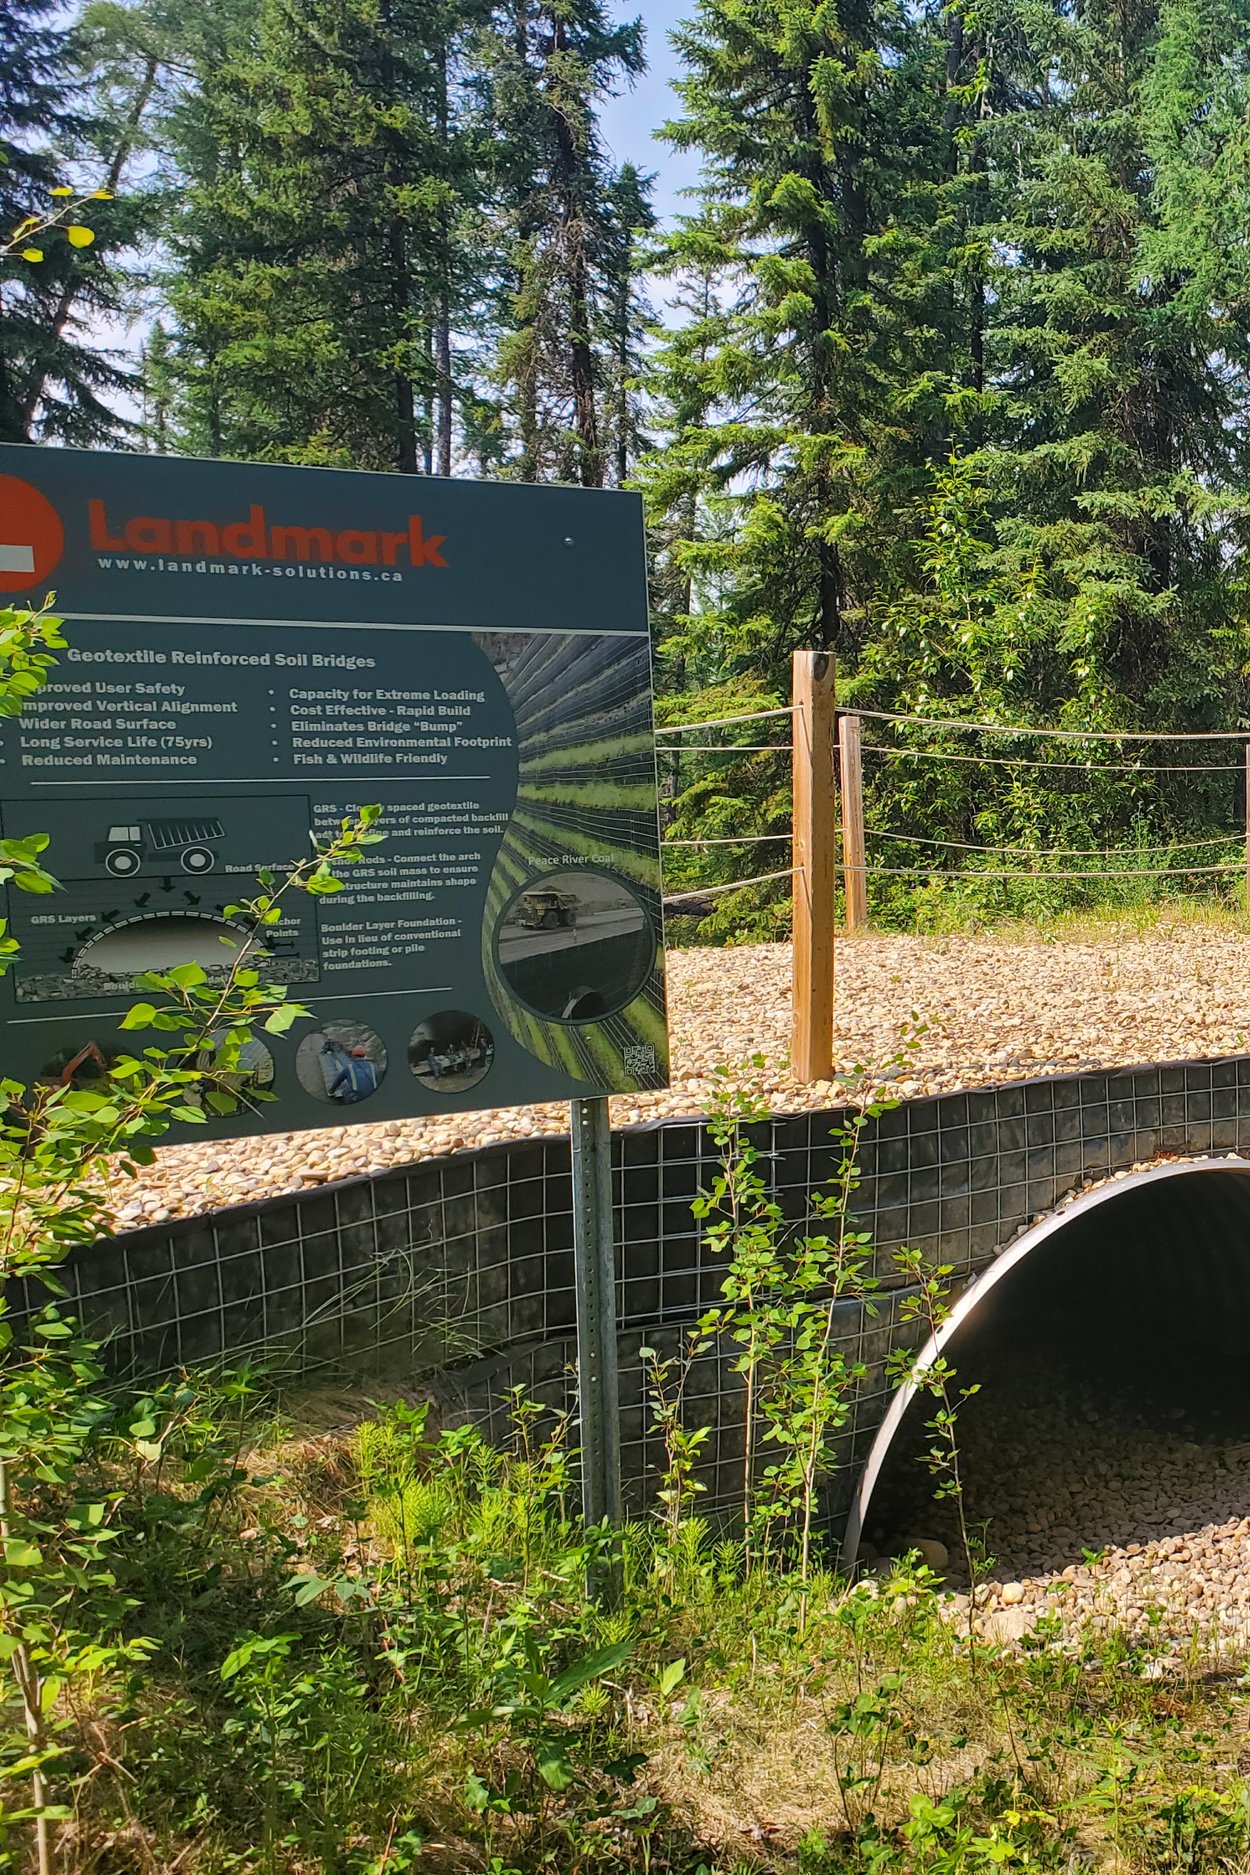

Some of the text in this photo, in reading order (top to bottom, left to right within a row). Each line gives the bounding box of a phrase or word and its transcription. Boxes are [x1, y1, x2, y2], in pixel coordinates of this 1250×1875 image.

[88, 498, 449, 568] Landmark
[98, 558, 403, 582] www.landmark-solutions.ca
[68, 649, 376, 670] Geotextile Reinforced Soil Bridges
[37, 682, 186, 696] proved User Safety
[289, 688, 486, 702] Capacity for Extreme Loading
[23, 700, 238, 714] mproved Vertical Alignment
[290, 704, 323, 716] Cost
[325, 705, 387, 716] Effective
[396, 705, 435, 717] Rapid
[438, 705, 471, 716] Build
[19, 718, 177, 729] Wider Road Surface
[291, 721, 365, 732] Eliminates
[367, 721, 411, 734] Bridge
[20, 735, 213, 749] Long Service Life (75yrs)
[292, 736, 512, 748] Reduced Environmental Footprint
[22, 753, 198, 766] Reduced Maintenance
[293, 752, 448, 765] Fish & Wildlife Friendly
[313, 804, 337, 813] GRS
[387, 803, 425, 813] spaced
[427, 801, 480, 812] geotextile
[314, 817, 360, 826] betwen
[398, 815, 410, 824] of
[412, 814, 469, 825] compacted
[471, 812, 509, 822] backfill
[391, 828, 411, 837] and
[413, 826, 461, 836] reinforce
[463, 825, 481, 834] the
[483, 825, 504, 834] soil.
[393, 853, 437, 863] Connect
[439, 852, 456, 861] the
[458, 851, 481, 860] arch
[528, 852, 615, 865] Peace River Coal
[225, 864, 253, 873] Road
[331, 865, 479, 878] the GRS soil mass to ensure
[345, 877, 476, 891] tructure maintains shape
[319, 891, 435, 905] during the backfilling.
[31, 914, 97, 924] GRS Layers
[321, 923, 364, 932] Boulder
[366, 921, 396, 931] Layer
[397, 918, 456, 928] Foundation
[265, 929, 300, 938] Points
[322, 929, 461, 945] Use in lieu of conventional
[322, 943, 425, 958] strip footing or pile
[322, 959, 392, 971] foundations.
